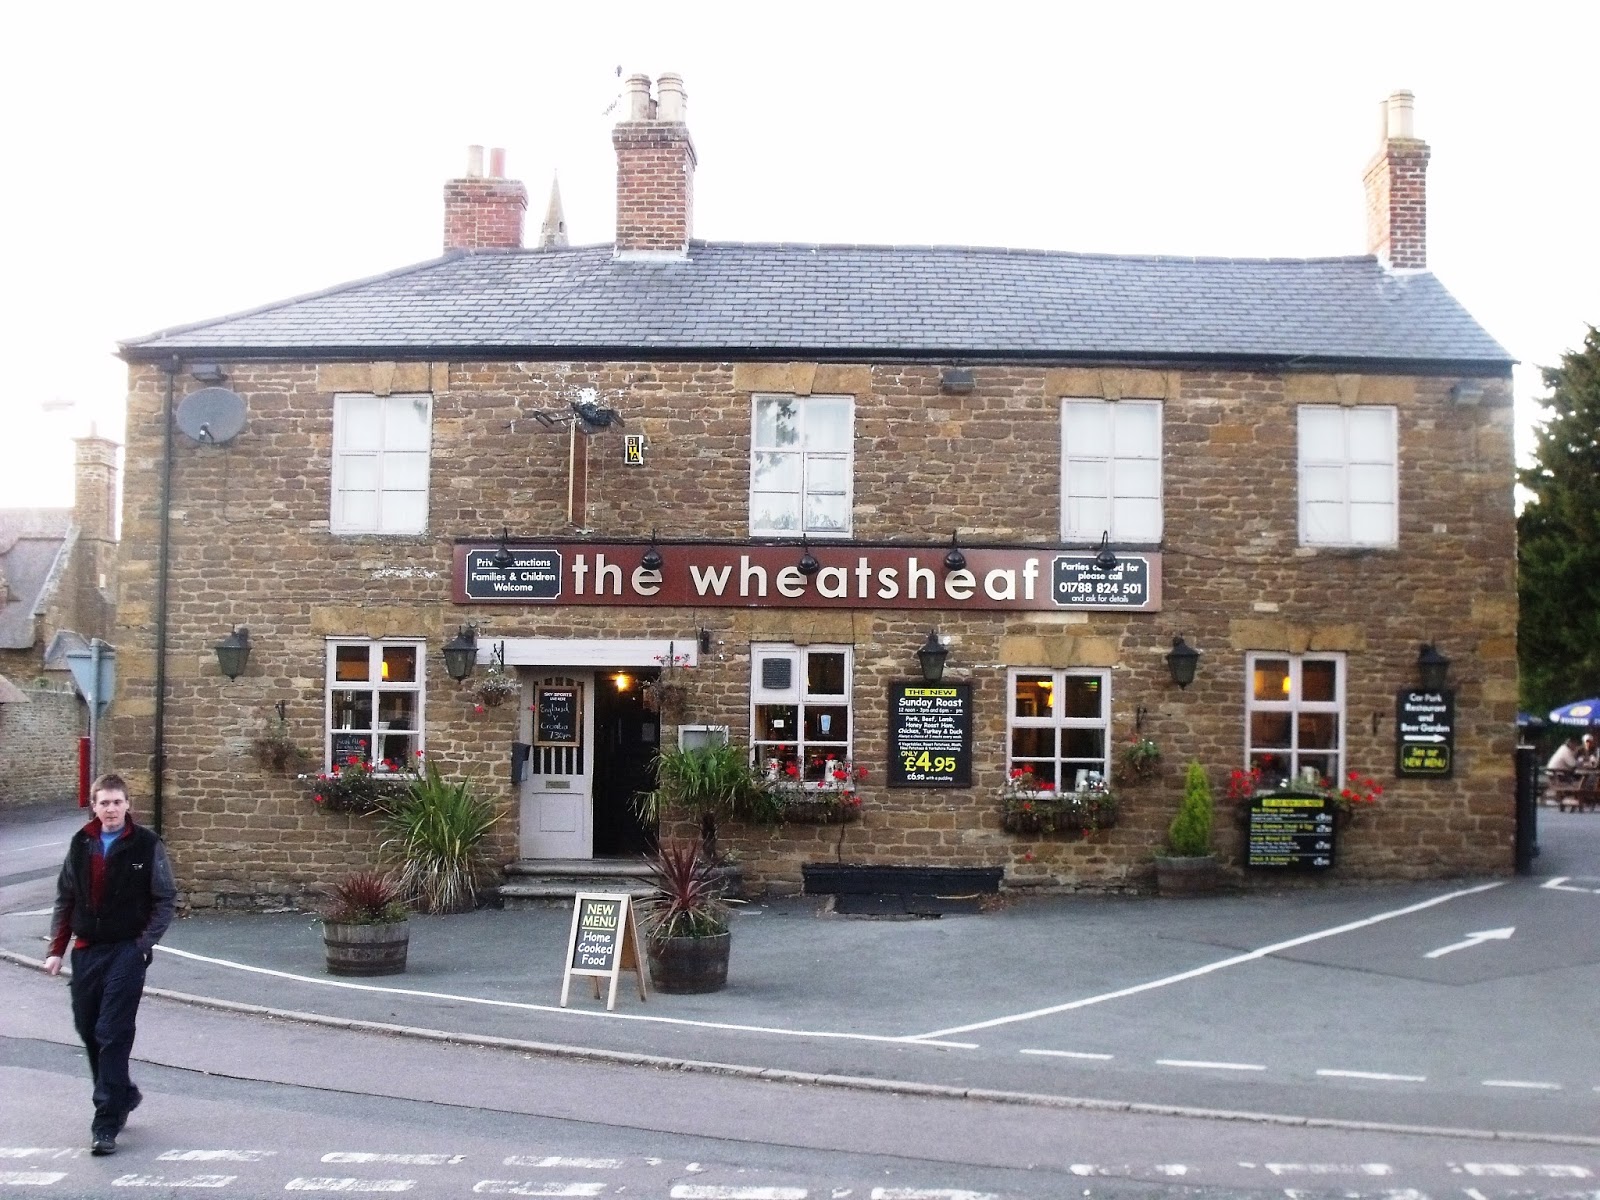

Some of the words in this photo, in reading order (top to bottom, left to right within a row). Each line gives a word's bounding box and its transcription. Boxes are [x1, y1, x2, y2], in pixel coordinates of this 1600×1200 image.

[512, 558, 551, 567] unctions
[1061, 562, 1090, 571] Parties
[1126, 562, 1139, 572] for
[471, 572, 506, 581] Families
[509, 573, 517, 581] &
[520, 572, 556, 581] Children
[571, 554, 663, 597] the
[689, 555, 1039, 600] wheatsheaf
[1077, 571, 1106, 581] please
[1108, 572, 1123, 580] call
[493, 582, 533, 591] Welcome
[1059, 582, 1092, 593] 01788
[1096, 583, 1119, 594] 824
[1122, 583, 1142, 594] 501
[1071, 594, 1084, 602] and
[1108, 595, 1129, 603] details
[898, 698, 933, 708] Sunday
[936, 698, 963, 707] Roast
[540, 702, 570, 716] England
[540, 722, 569, 730] Croatia
[904, 751, 956, 772] £4.95
[587, 904, 615, 915] NEW
[582, 915, 617, 928] MENU
[583, 931, 611, 943] Home
[577, 943, 613, 955] Cooked
[581, 954, 607, 966] Food
